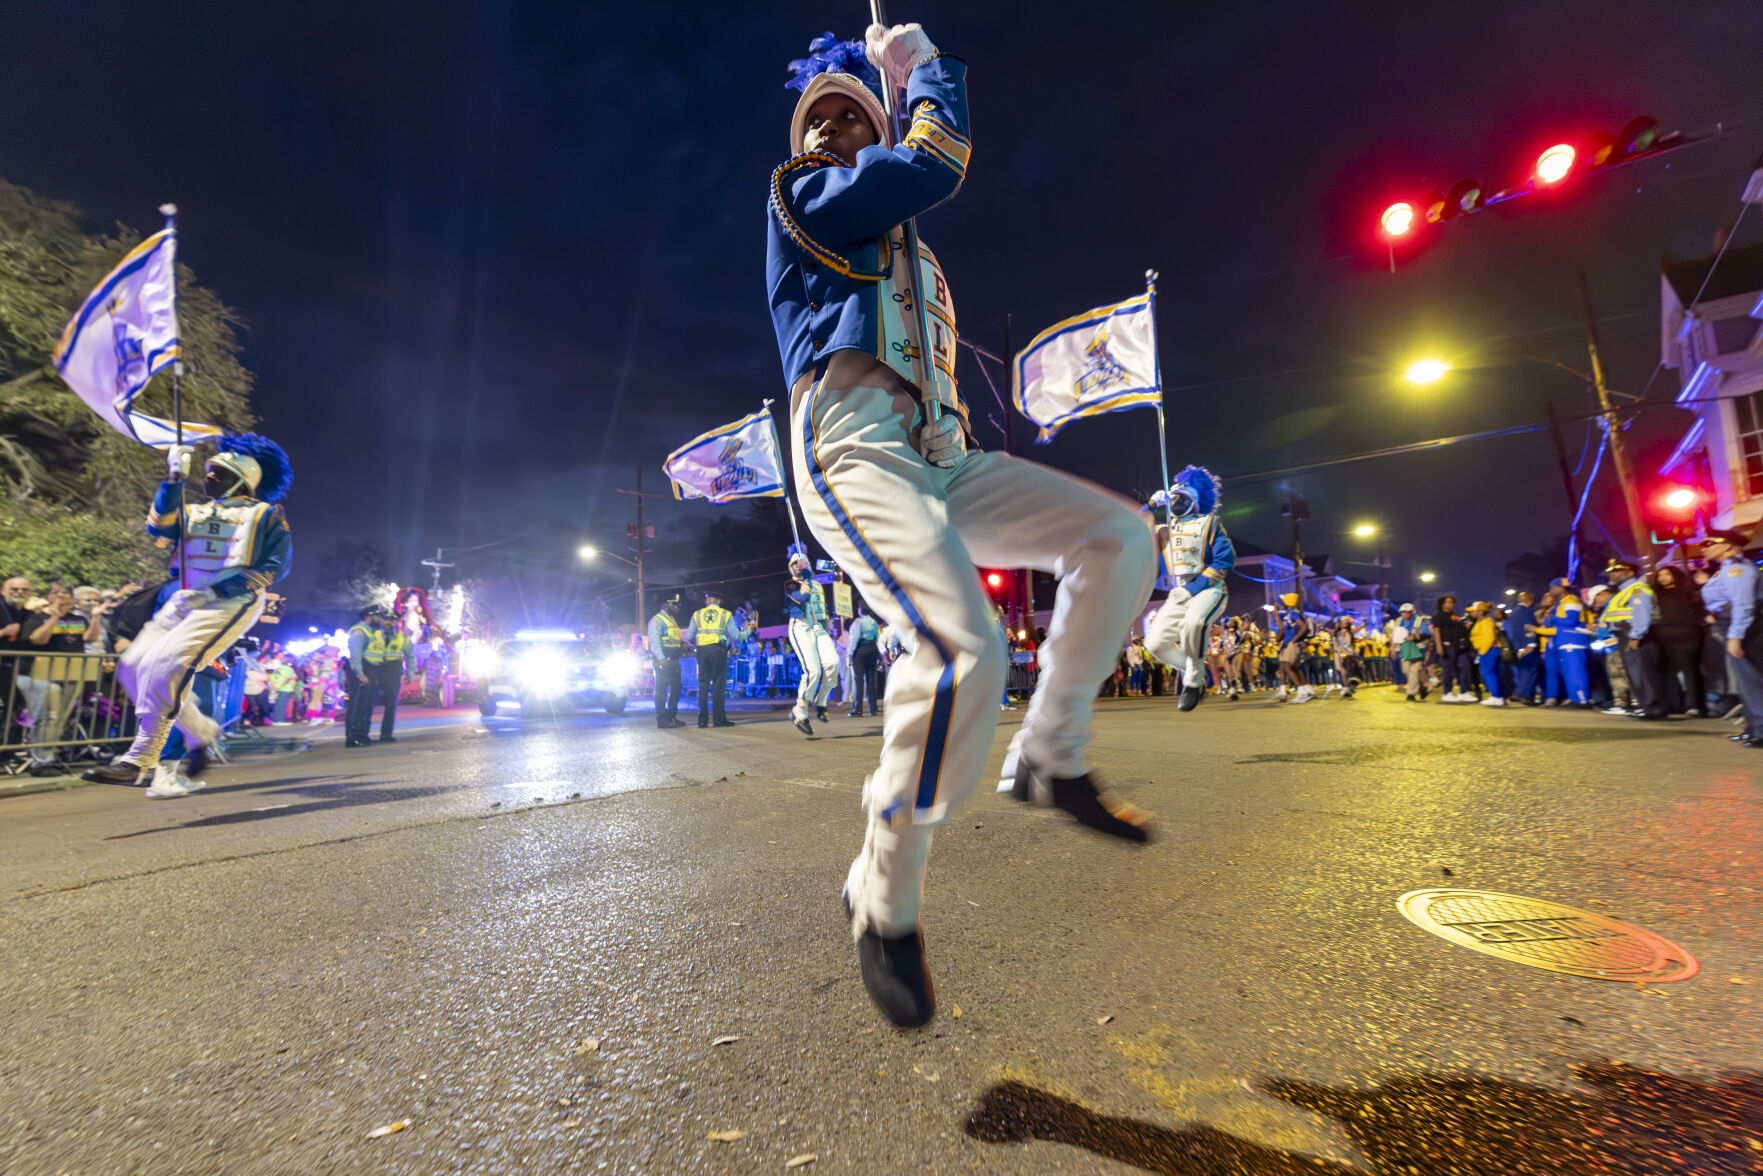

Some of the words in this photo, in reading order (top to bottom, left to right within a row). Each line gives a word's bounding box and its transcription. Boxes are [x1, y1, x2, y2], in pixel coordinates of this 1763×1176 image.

[933, 270, 947, 308] B
[934, 320, 948, 360] L
[208, 522, 221, 535] B
[205, 540, 217, 553] L
